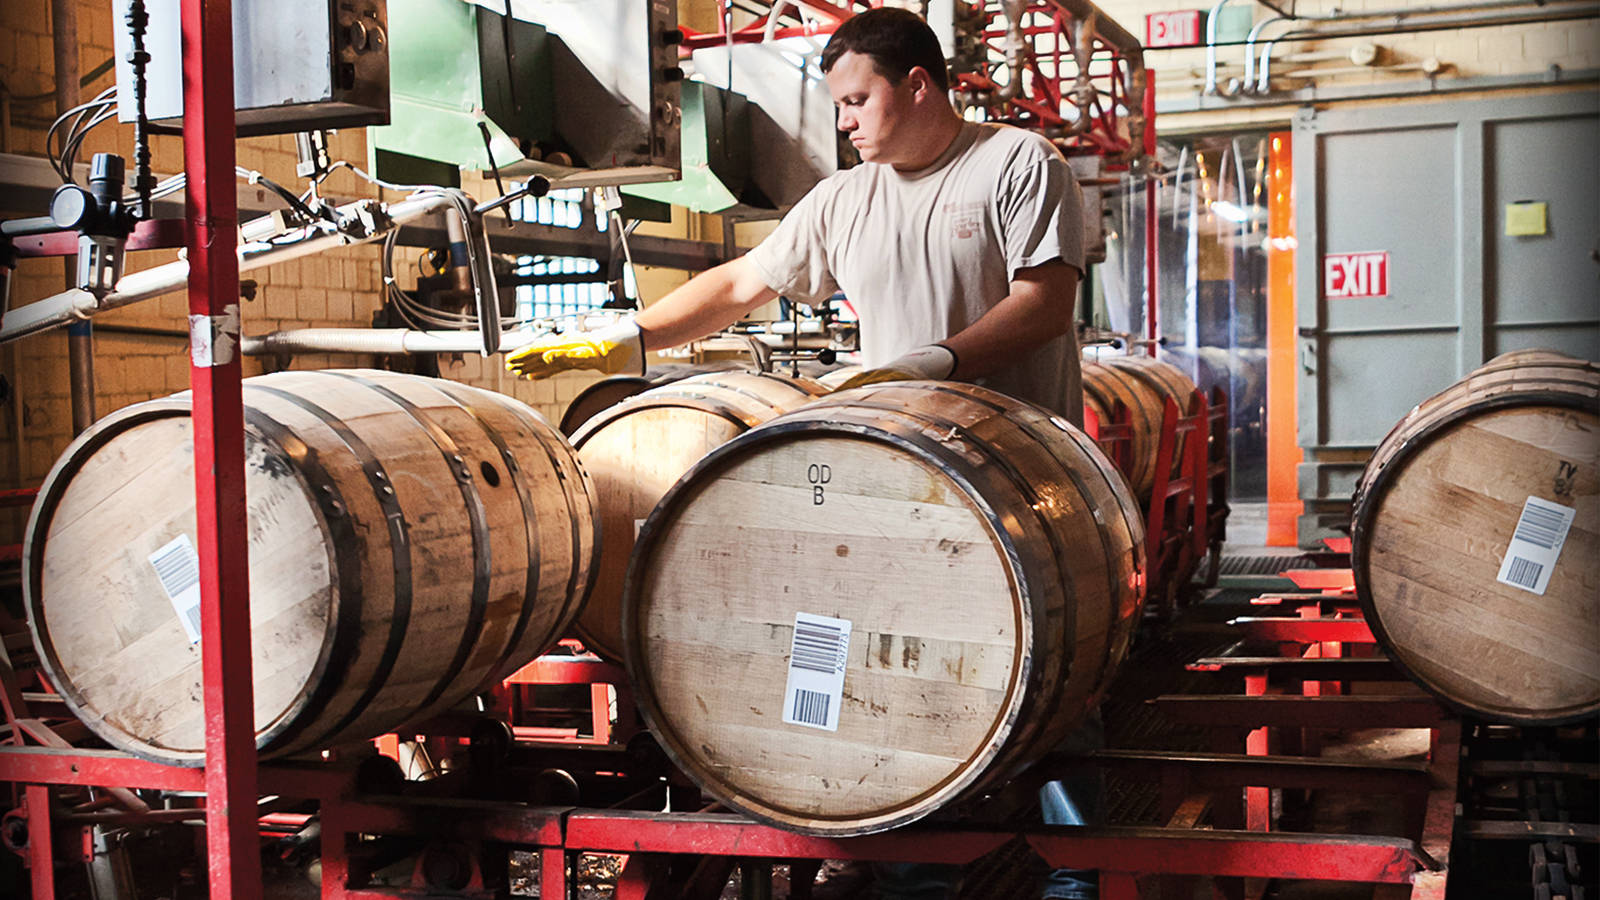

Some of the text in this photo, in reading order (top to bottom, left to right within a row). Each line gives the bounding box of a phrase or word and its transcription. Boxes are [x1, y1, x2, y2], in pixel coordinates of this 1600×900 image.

[1150, 11, 1196, 46] EXIT
[1324, 255, 1384, 296] EXIT
[807, 463, 832, 484] OD
[813, 485, 825, 506] B
[836, 633, 849, 672] A297773
